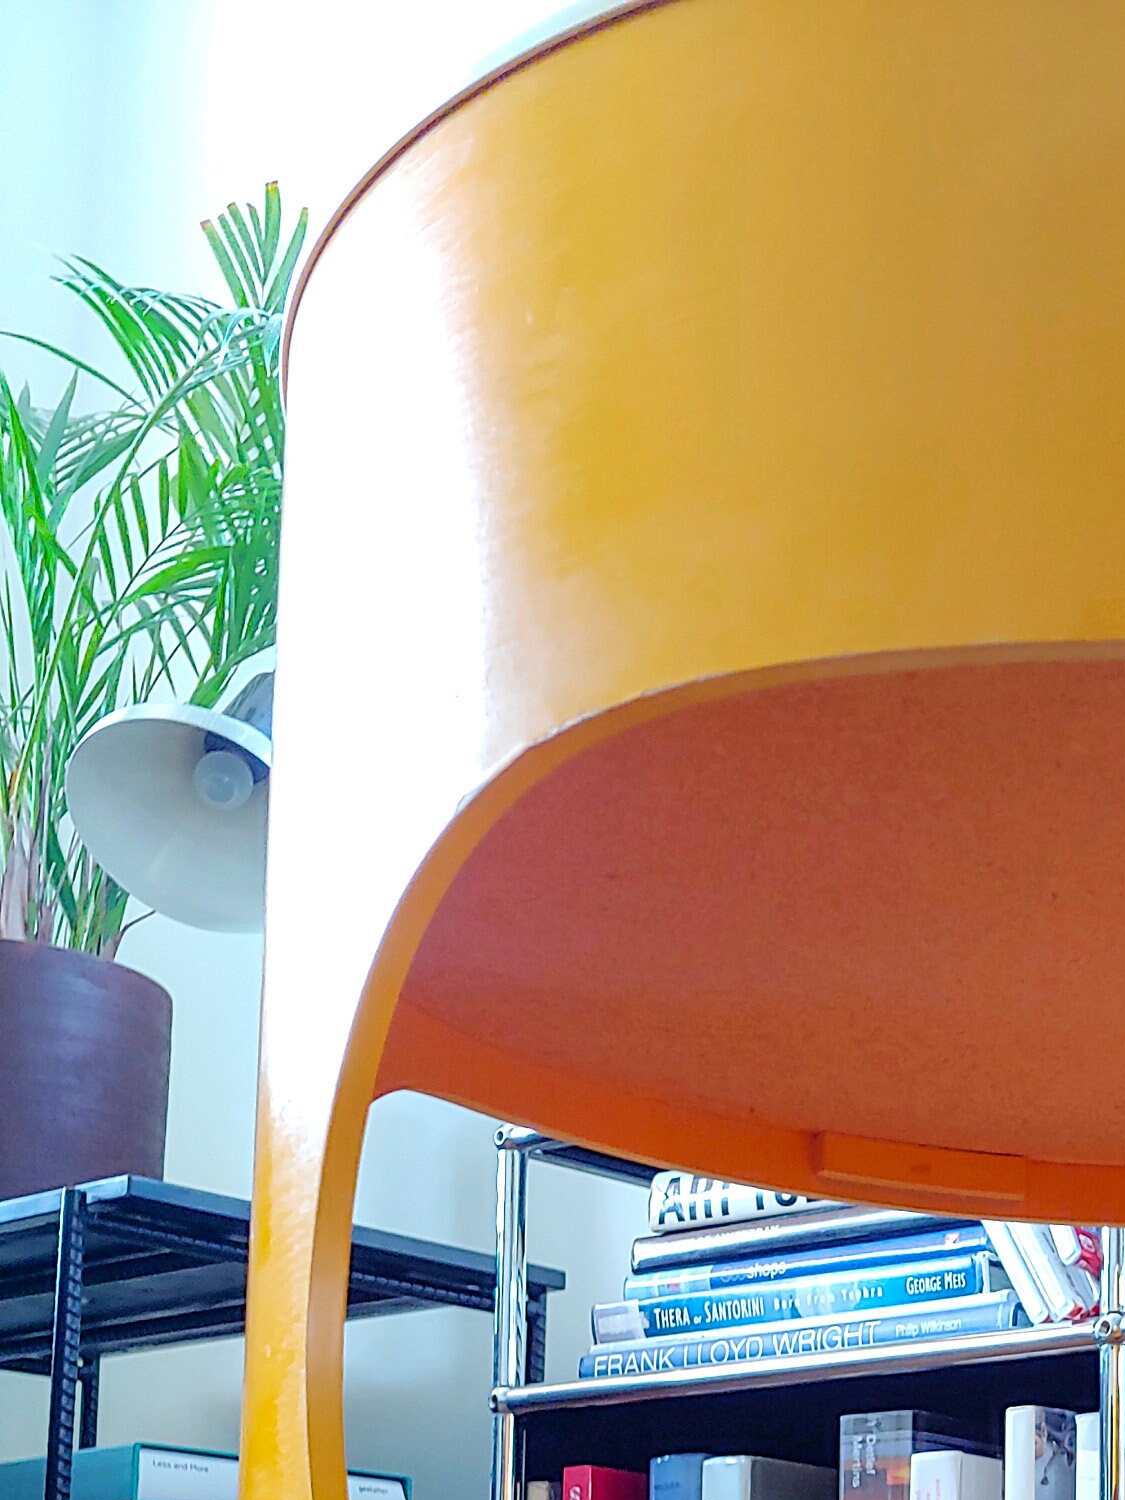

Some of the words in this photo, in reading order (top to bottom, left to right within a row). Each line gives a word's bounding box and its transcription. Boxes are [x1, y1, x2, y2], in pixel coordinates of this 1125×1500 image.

[906, 1276, 942, 1295] GEORGE
[705, 1297, 764, 1324] SANTORINI
[593, 1346, 675, 1379] FRANK
[683, 1335, 764, 1368] LLOYD
[772, 1320, 882, 1357] WRIGHT
[153, 1459, 172, 1469] Less
[174, 1463, 188, 1471] and
[190, 1463, 209, 1473] More
